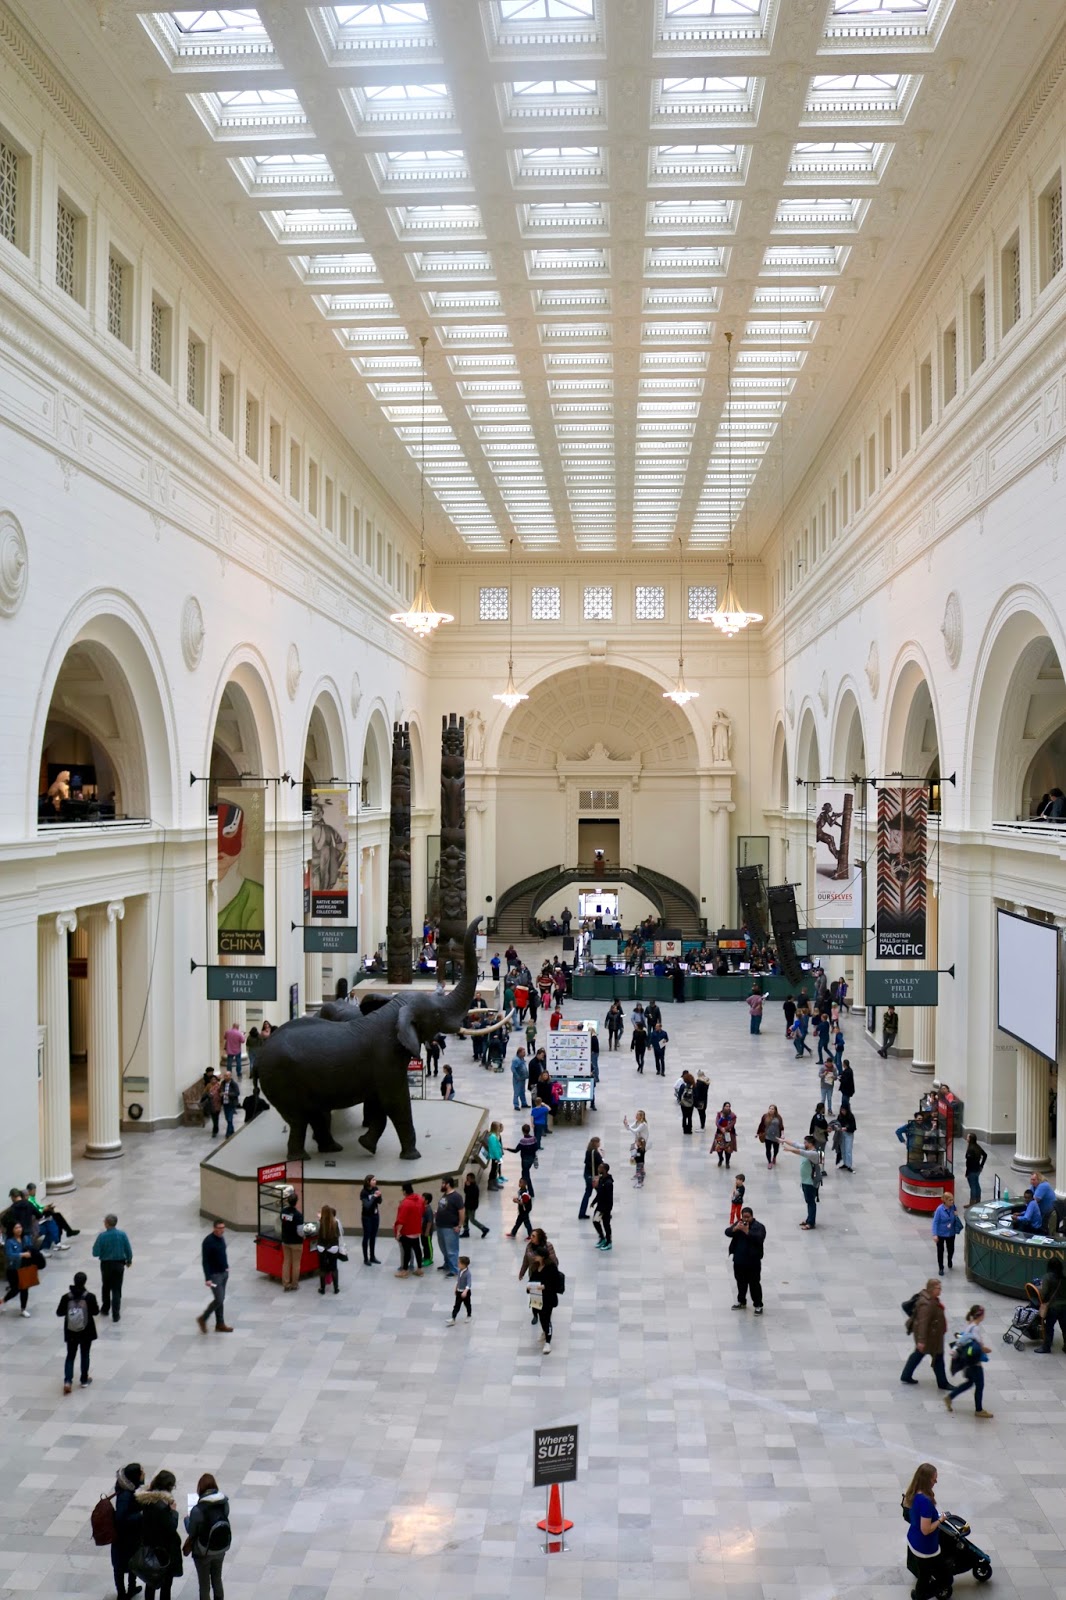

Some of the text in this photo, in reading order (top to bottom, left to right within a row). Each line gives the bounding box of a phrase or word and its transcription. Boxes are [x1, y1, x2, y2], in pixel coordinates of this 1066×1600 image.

[220, 939, 262, 950] CHINA
[880, 944, 923, 955] PACIFIC
[972, 1232, 1064, 1260] INFORMATION
[538, 1434, 574, 1446] Where's
[538, 1443, 574, 1459] SUE?
